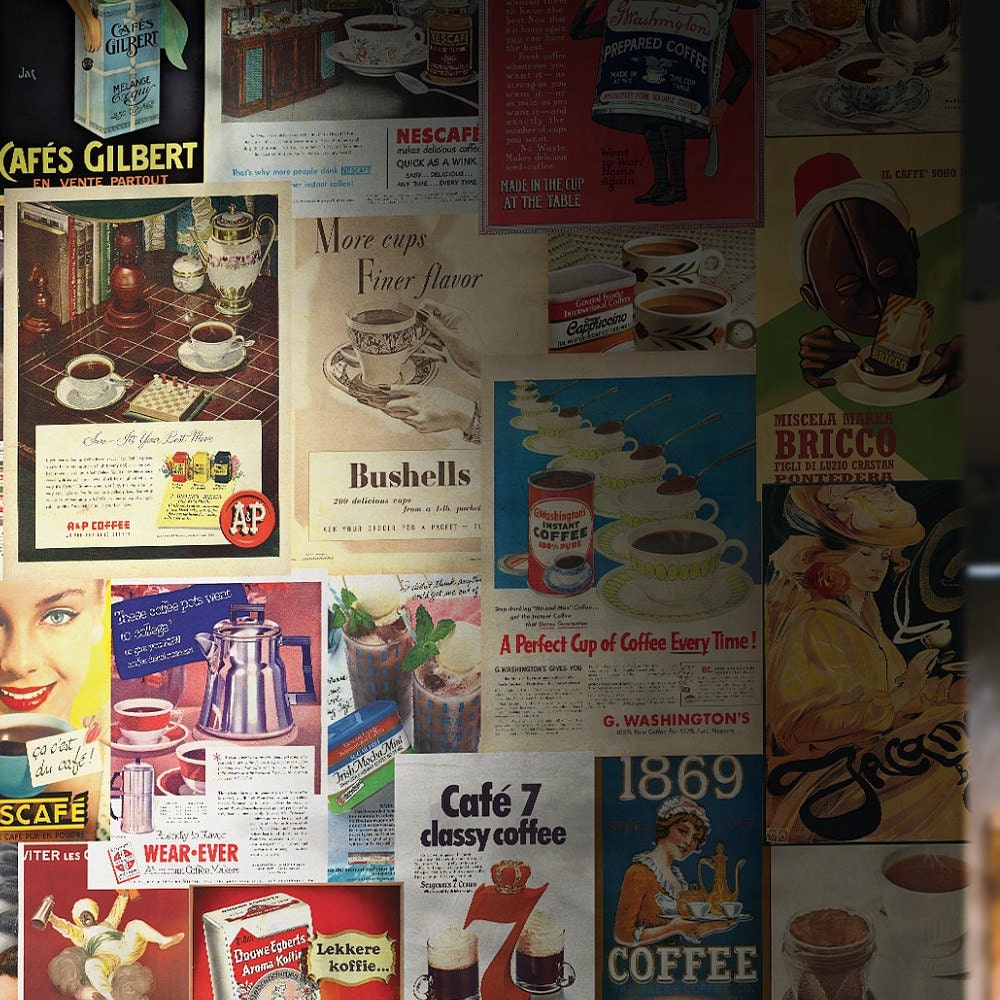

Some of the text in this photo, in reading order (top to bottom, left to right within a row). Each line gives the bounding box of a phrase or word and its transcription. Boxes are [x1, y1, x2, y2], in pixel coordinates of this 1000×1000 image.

[106, 31, 158, 57] GILBERT
[605, 37, 708, 74] PREPARED COFFEE
[84, 141, 197, 172] GILBERT
[452, 157, 477, 166] WINK
[33, 175, 168, 188] EN VENTE PARTOUT
[500, 178, 584, 192] MADE IN THE CUP
[504, 195, 580, 209] AT THE TABLE
[315, 217, 427, 255] More cups
[358, 258, 483, 299] Finer flavor
[774, 413, 837, 426] MISCELA
[775, 428, 896, 459] BRICCO
[349, 461, 471, 489] Bushells
[852, 460, 894, 470] CRASTAN
[92, 520, 130, 530] COFFEE
[534, 526, 588, 541] COFFEE
[500, 634, 511, 655] A
[516, 634, 566, 654] Perfect
[570, 633, 598, 657] Cup
[601, 634, 617, 650] of
[620, 633, 666, 650] Coffee
[671, 632, 709, 656] Every
[604, 712, 750, 728] G. WASHINGTON'S
[619, 756, 744, 801] 1869
[441, 782, 542, 818] Café 7
[420, 820, 491, 852] classy
[493, 819, 567, 845] coffee
[64, 853, 80, 861] LES
[233, 933, 307, 965] Douwe Egberts
[317, 943, 381, 956] Lekkere
[607, 945, 759, 984] COFFEE
